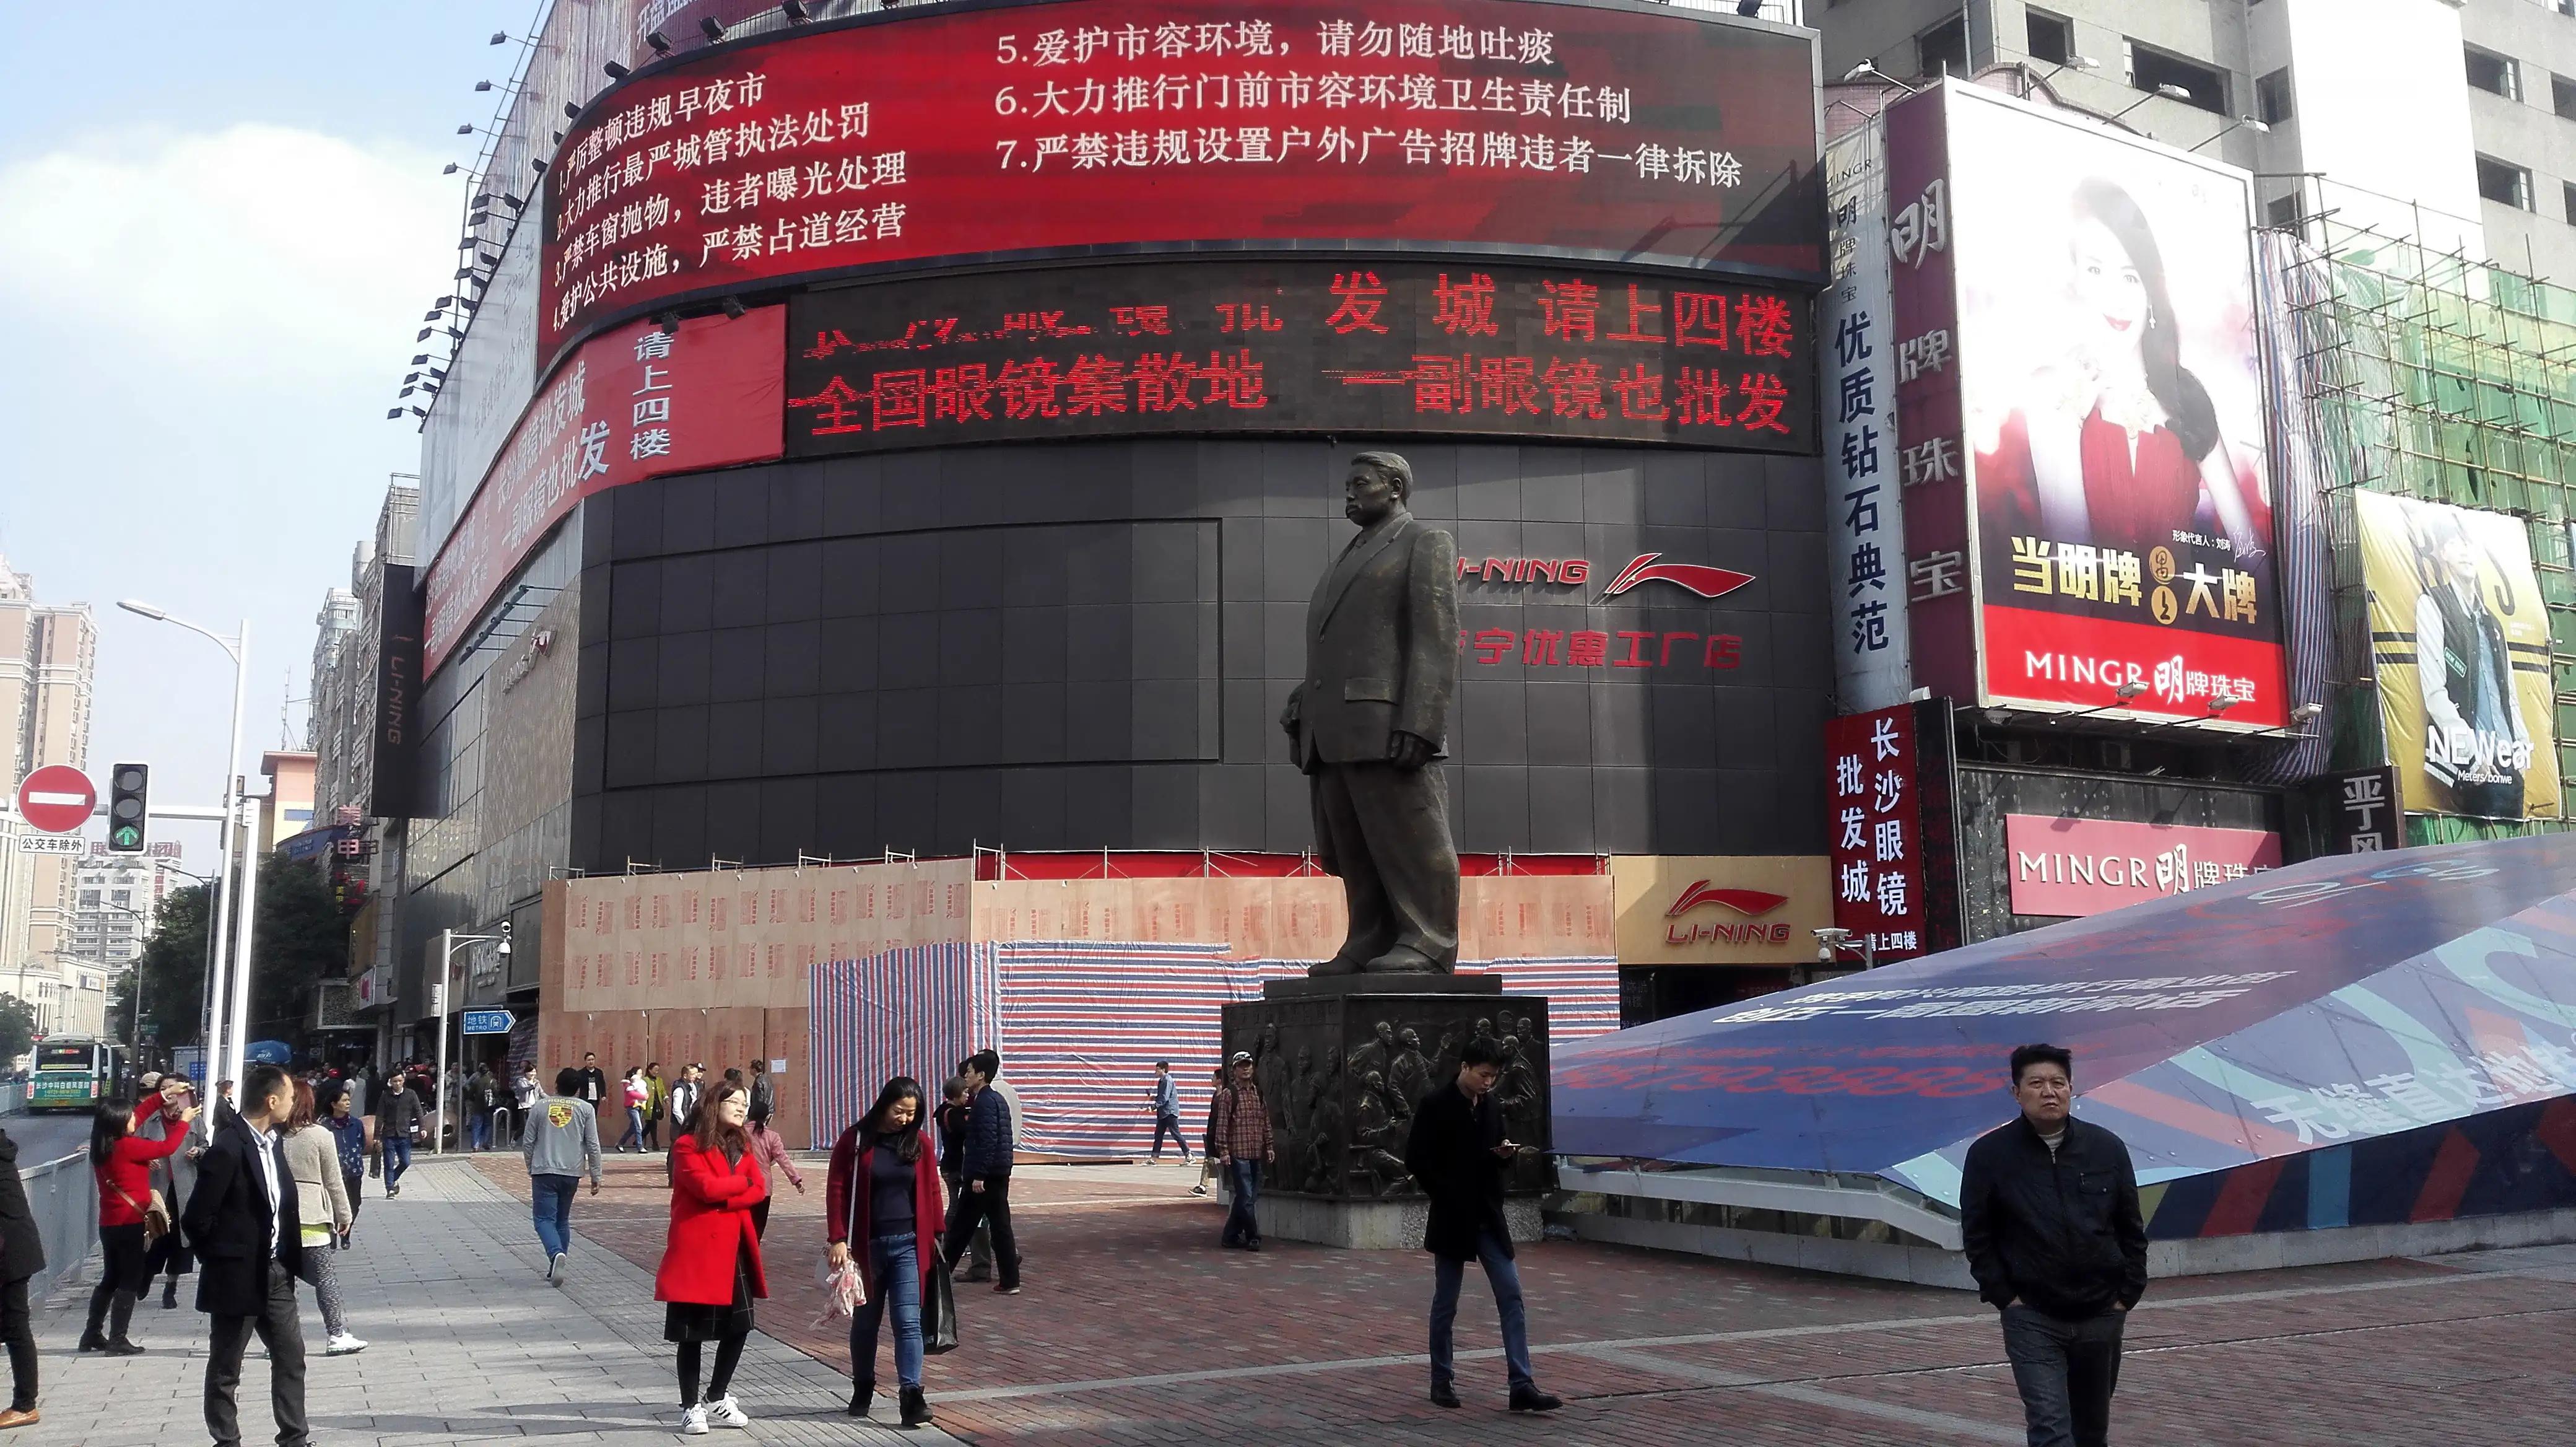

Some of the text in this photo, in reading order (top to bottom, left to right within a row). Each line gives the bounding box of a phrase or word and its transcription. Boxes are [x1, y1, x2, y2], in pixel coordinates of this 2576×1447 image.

[996, 20, 1554, 67] 5.爱护市容环境，请勿随地吐痰
[995, 71, 1631, 125] 6.大力推行门前市容环境卫生责任制
[559, 72, 766, 196] 1.严厉整顿违规早夜市
[996, 125, 1742, 189] 7.严禁违规设置户外广告招牌违者一律拆除
[556, 102, 869, 242] 2.大力推行最严城管执法处罚
[1837, 195, 1857, 304] 明牌珠宝
[629, 331, 674, 461] 请上四楼
[810, 349, 1790, 436] 全国眼镜集散地 一副眼镜也批发
[1892, 178, 1963, 603] 明牌珠宝
[498, 360, 586, 513] 长沙眼镜批发城
[502, 420, 610, 553] 一副眼镜也批发
[1834, 311, 1889, 654] 优质钻石典范
[2172, 530, 2230, 551] 形象代言人：刘涛
[1457, 557, 1590, 584] I-NING
[1457, 627, 1742, 669] 宁优惠工厂店
[2026, 651, 2142, 686] MINGR
[388, 655, 404, 745] LI-NING
[2154, 655, 2255, 704] 明牌珠宝
[2458, 768, 2512, 785] Meters/bonwe
[22, 838, 82, 851] 公交车除外
[1837, 754, 1870, 903] 批发城
[1871, 717, 1907, 916] 长沙眼镜
[2018, 851, 2149, 887] MINGR
[1665, 924, 1791, 943] LI-NING
[467, 1015, 487, 1025] 地铁
[1712, 988, 2252, 1023] 创五一商圈新神话
